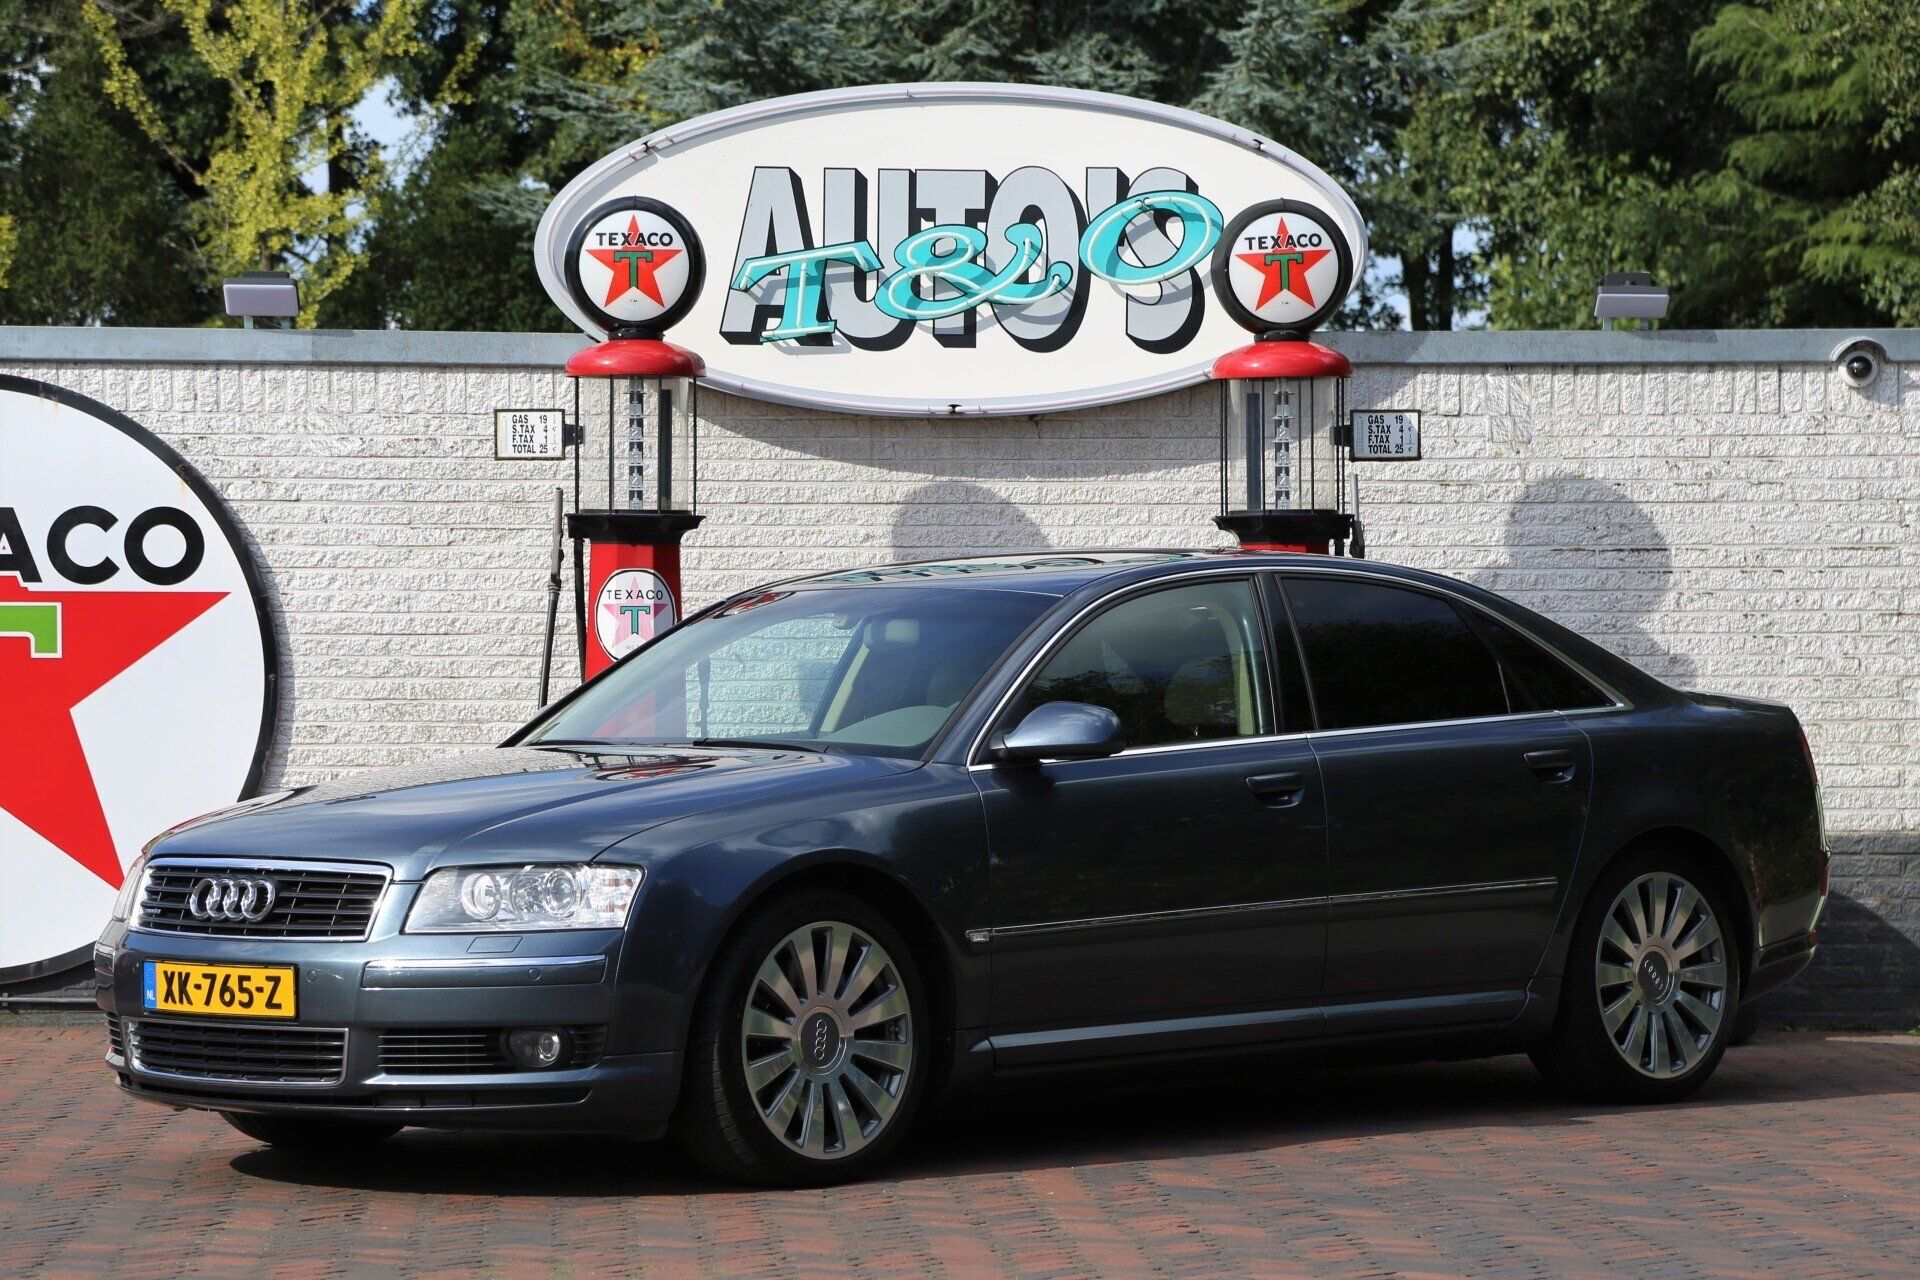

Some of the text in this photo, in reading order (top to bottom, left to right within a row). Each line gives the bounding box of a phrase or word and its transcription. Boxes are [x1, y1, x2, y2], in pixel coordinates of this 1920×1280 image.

[595, 232, 674, 247] TEXACO
[1244, 233, 1322, 250] TEXACO
[719, 165, 1206, 354] AUTO'S
[512, 414, 547, 424] GAS 19
[1367, 414, 1403, 424] GAS 19
[512, 424, 547, 434] S.TAX 4
[1367, 424, 1403, 434] S.TAX 4
[512, 434, 547, 444] F.TAX 1
[1368, 434, 1403, 444] F.TAX 1
[512, 444, 548, 453] TOTAL 25
[1368, 444, 1403, 453] TOTAL 25
[607, 589, 663, 600] TEXACO
[163, 970, 282, 1009] XK-765-Z
[146, 990, 156, 1000] NL
